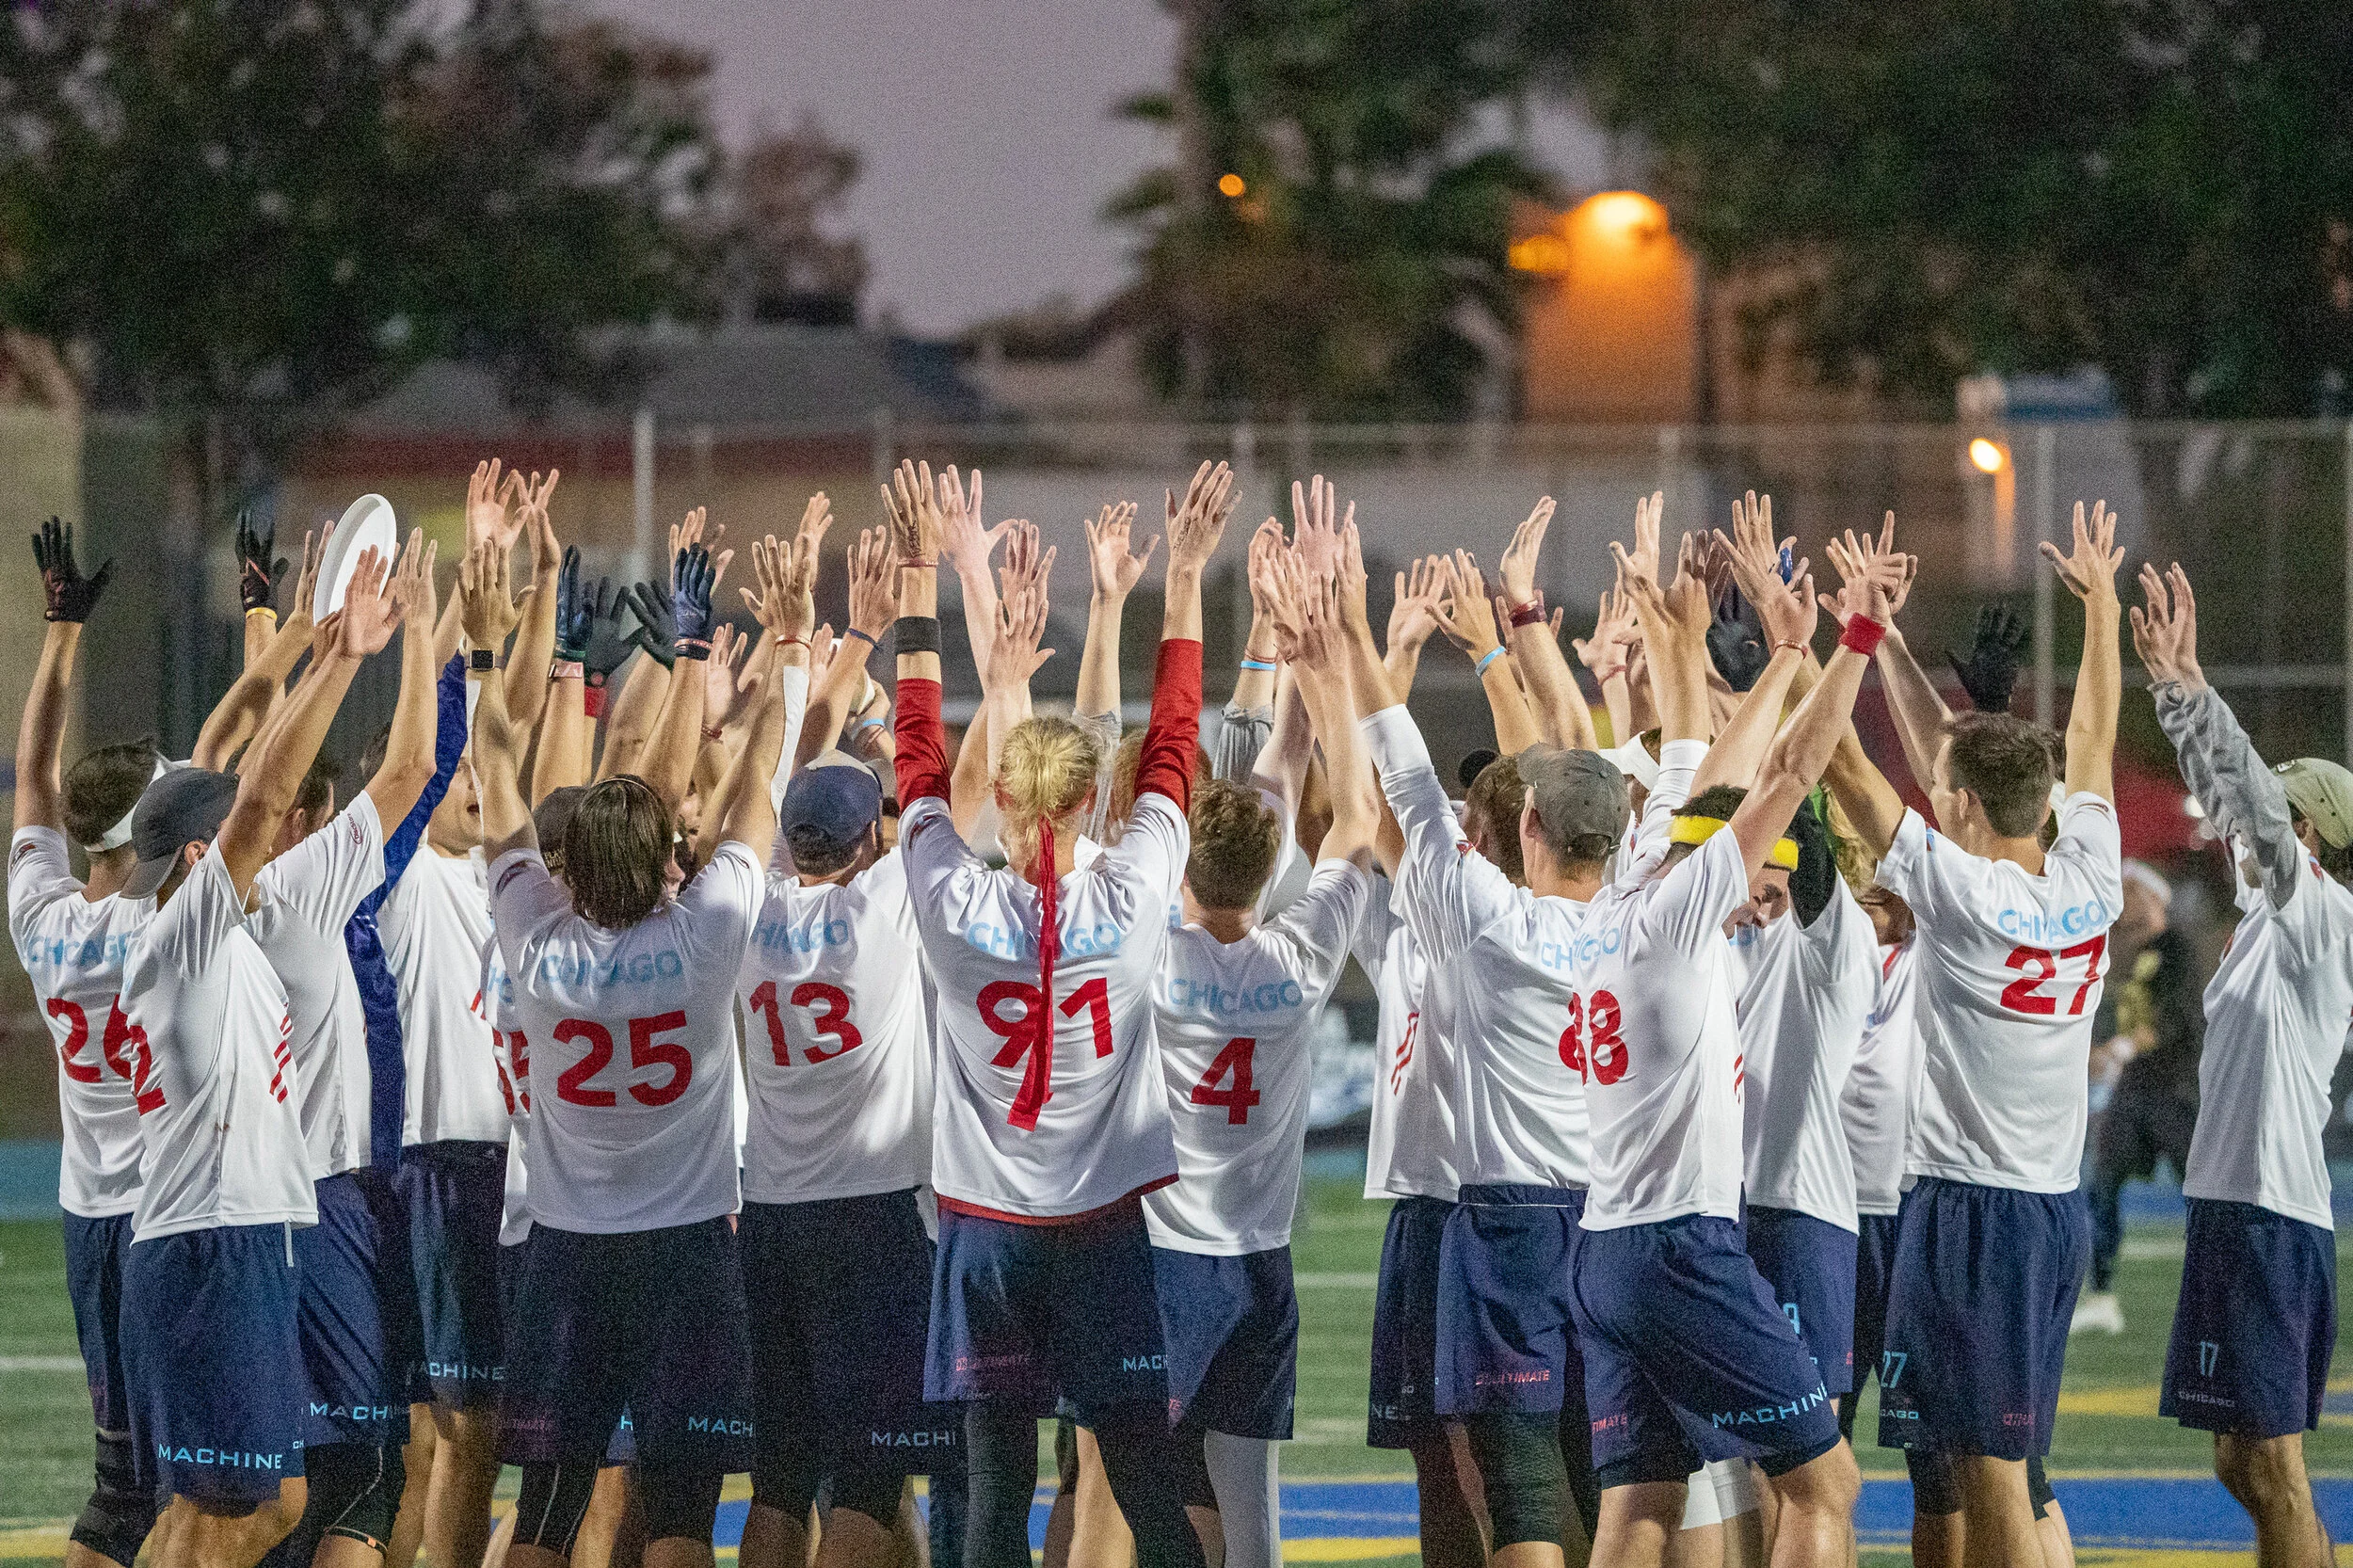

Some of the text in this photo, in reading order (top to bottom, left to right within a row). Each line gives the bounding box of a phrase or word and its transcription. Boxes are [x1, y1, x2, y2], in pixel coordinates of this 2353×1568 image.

[968, 921, 1121, 959] CHIGO
[1997, 900, 2105, 942] CHIAGO
[1168, 978, 1304, 1016] CHICAGO
[2000, 933, 2106, 1015] 27
[47, 994, 133, 1083] 26
[552, 1010, 693, 1107] 25
[749, 980, 863, 1067] 13
[976, 977, 1113, 1068] 91
[1191, 1037, 1261, 1125] 4
[2199, 1340, 2219, 1377] 17
[157, 1442, 283, 1470] MACHINE
